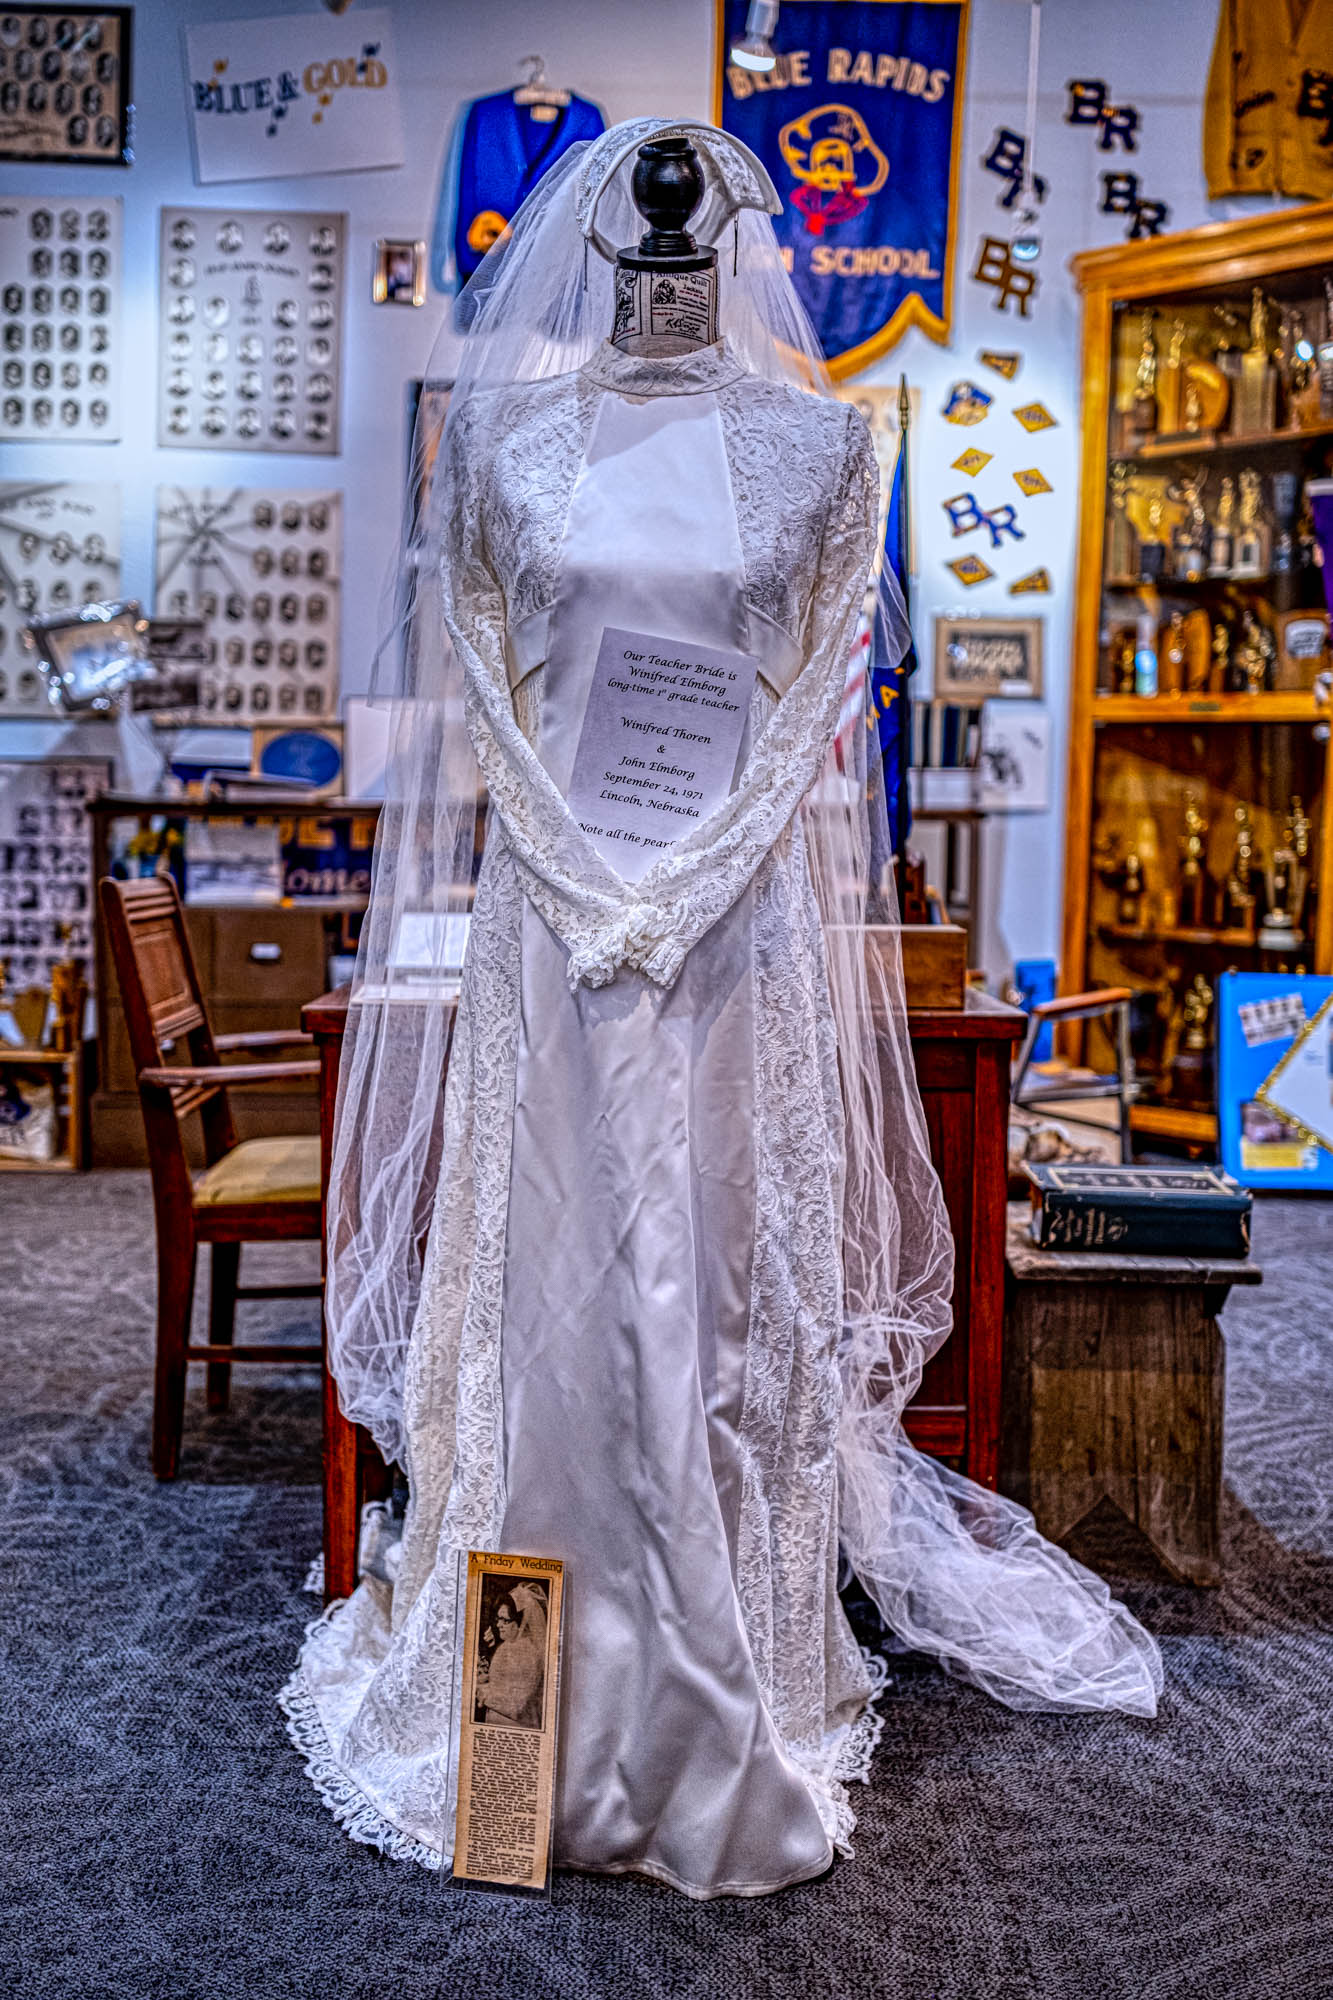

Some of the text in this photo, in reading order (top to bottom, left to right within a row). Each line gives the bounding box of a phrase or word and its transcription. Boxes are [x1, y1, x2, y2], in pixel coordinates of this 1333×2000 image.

[193, 57, 388, 113] BLUE & GOLD
[827, 48, 950, 103] RAPIDS
[810, 245, 941, 279] SCHOOL
[623, 650, 737, 681] Our Teacher Bride is
[607, 677, 655, 695] long-time
[667, 689, 699, 704] grade
[701, 697, 740, 712] teacher
[628, 665, 726, 697] Winifred Elmborg
[621, 717, 712, 744] Winifred Thoren
[656, 744, 667, 754] &
[618, 756, 696, 781] John Elmborg
[603, 771, 704, 800] September 24, 1971
[600, 789, 700, 818] Lincoln, Nebraska
[578, 822, 603, 836] Note
[606, 828, 624, 839] all
[623, 832, 641, 843] the
[471, 1553, 562, 1574] A Friday Wedding
